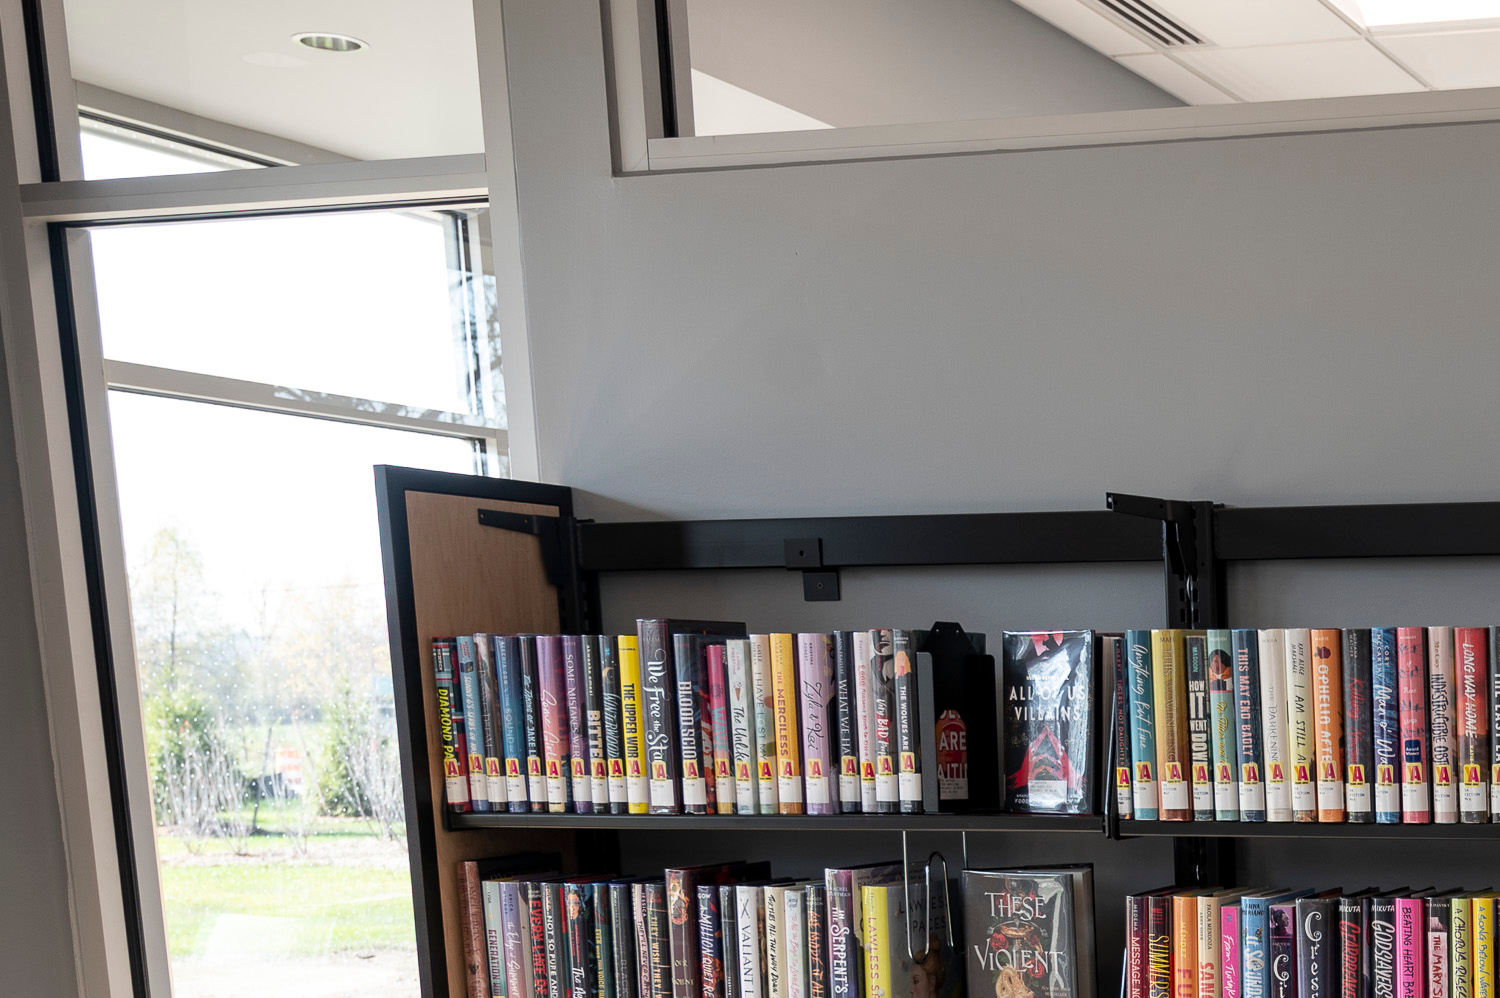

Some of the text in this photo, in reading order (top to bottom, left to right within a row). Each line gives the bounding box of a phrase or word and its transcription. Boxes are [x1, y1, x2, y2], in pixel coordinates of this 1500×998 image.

[803, 681, 823, 708] Zyla
[1010, 686, 1034, 700] ALL
[1068, 686, 1086, 699] US
[1189, 681, 1204, 691] HOW
[1317, 664, 1330, 725] OPHELIA
[1463, 643, 1478, 739] LONG WAY HOME
[438, 689, 453, 742] DIAMOND
[1014, 707, 1081, 721] VILLAINS
[1190, 692, 1204, 718] IT
[1238, 648, 1253, 756] THIS MAY END BADLY
[603, 692, 621, 758] WINTERWOOD
[777, 689, 788, 756] MERCILESS
[900, 702, 908, 734] WOLVES
[1190, 720, 1207, 731] WENT
[807, 724, 824, 750] Kai
[939, 732, 966, 750] ARE
[984, 892, 1046, 920] THESE
[1402, 907, 1411, 946] BEATING
[529, 900, 546, 994] EVERY LINE OF
[868, 917, 879, 980] LAWLESS
[974, 938, 1063, 973] VIOLENT
[1403, 949, 1413, 978] HEART
[1432, 955, 1442, 983] MARY
